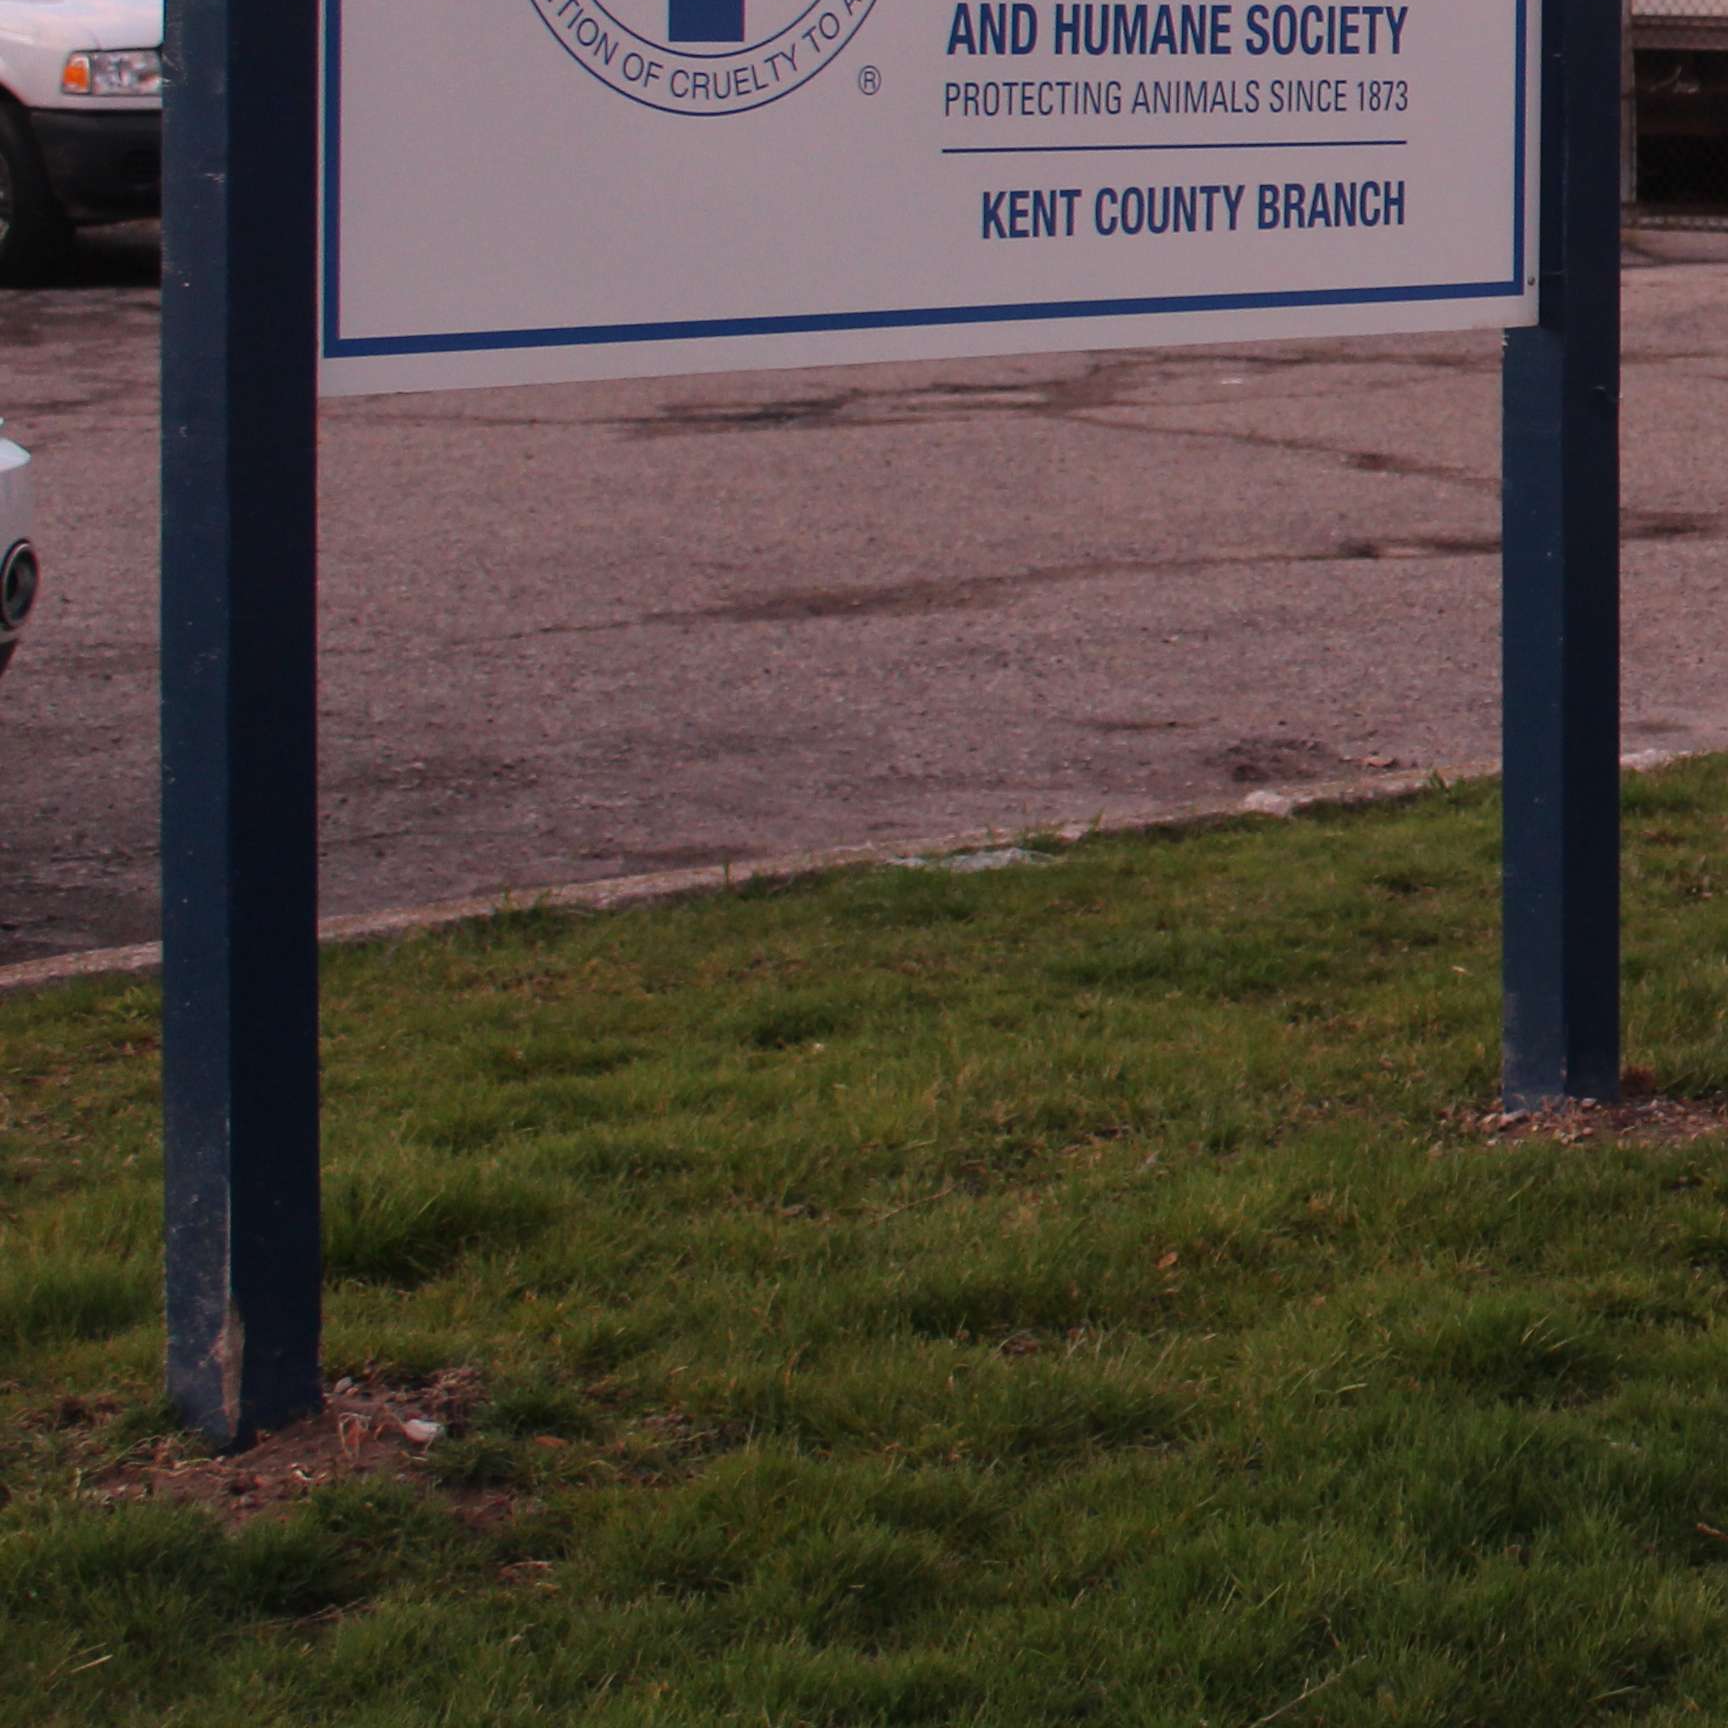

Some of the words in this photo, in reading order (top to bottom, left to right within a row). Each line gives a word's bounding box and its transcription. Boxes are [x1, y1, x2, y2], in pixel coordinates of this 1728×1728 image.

[622, 52, 663, 88] OF
[669, 44, 797, 100] CRUELTY
[801, 11, 840, 53] TO
[946, 2, 1038, 56] AND
[1053, 3, 1232, 55] HUMANE
[1245, 3, 1409, 56] SOCIETY
[944, 80, 1122, 117] PROTECTING
[1131, 79, 1260, 115] ANIMALS
[1269, 79, 1347, 113] SINCE
[1357, 80, 1408, 112] 1873
[981, 188, 1082, 240] KENT
[1093, 184, 1246, 237] COUNTY
[1257, 180, 1405, 230] BRANCH
